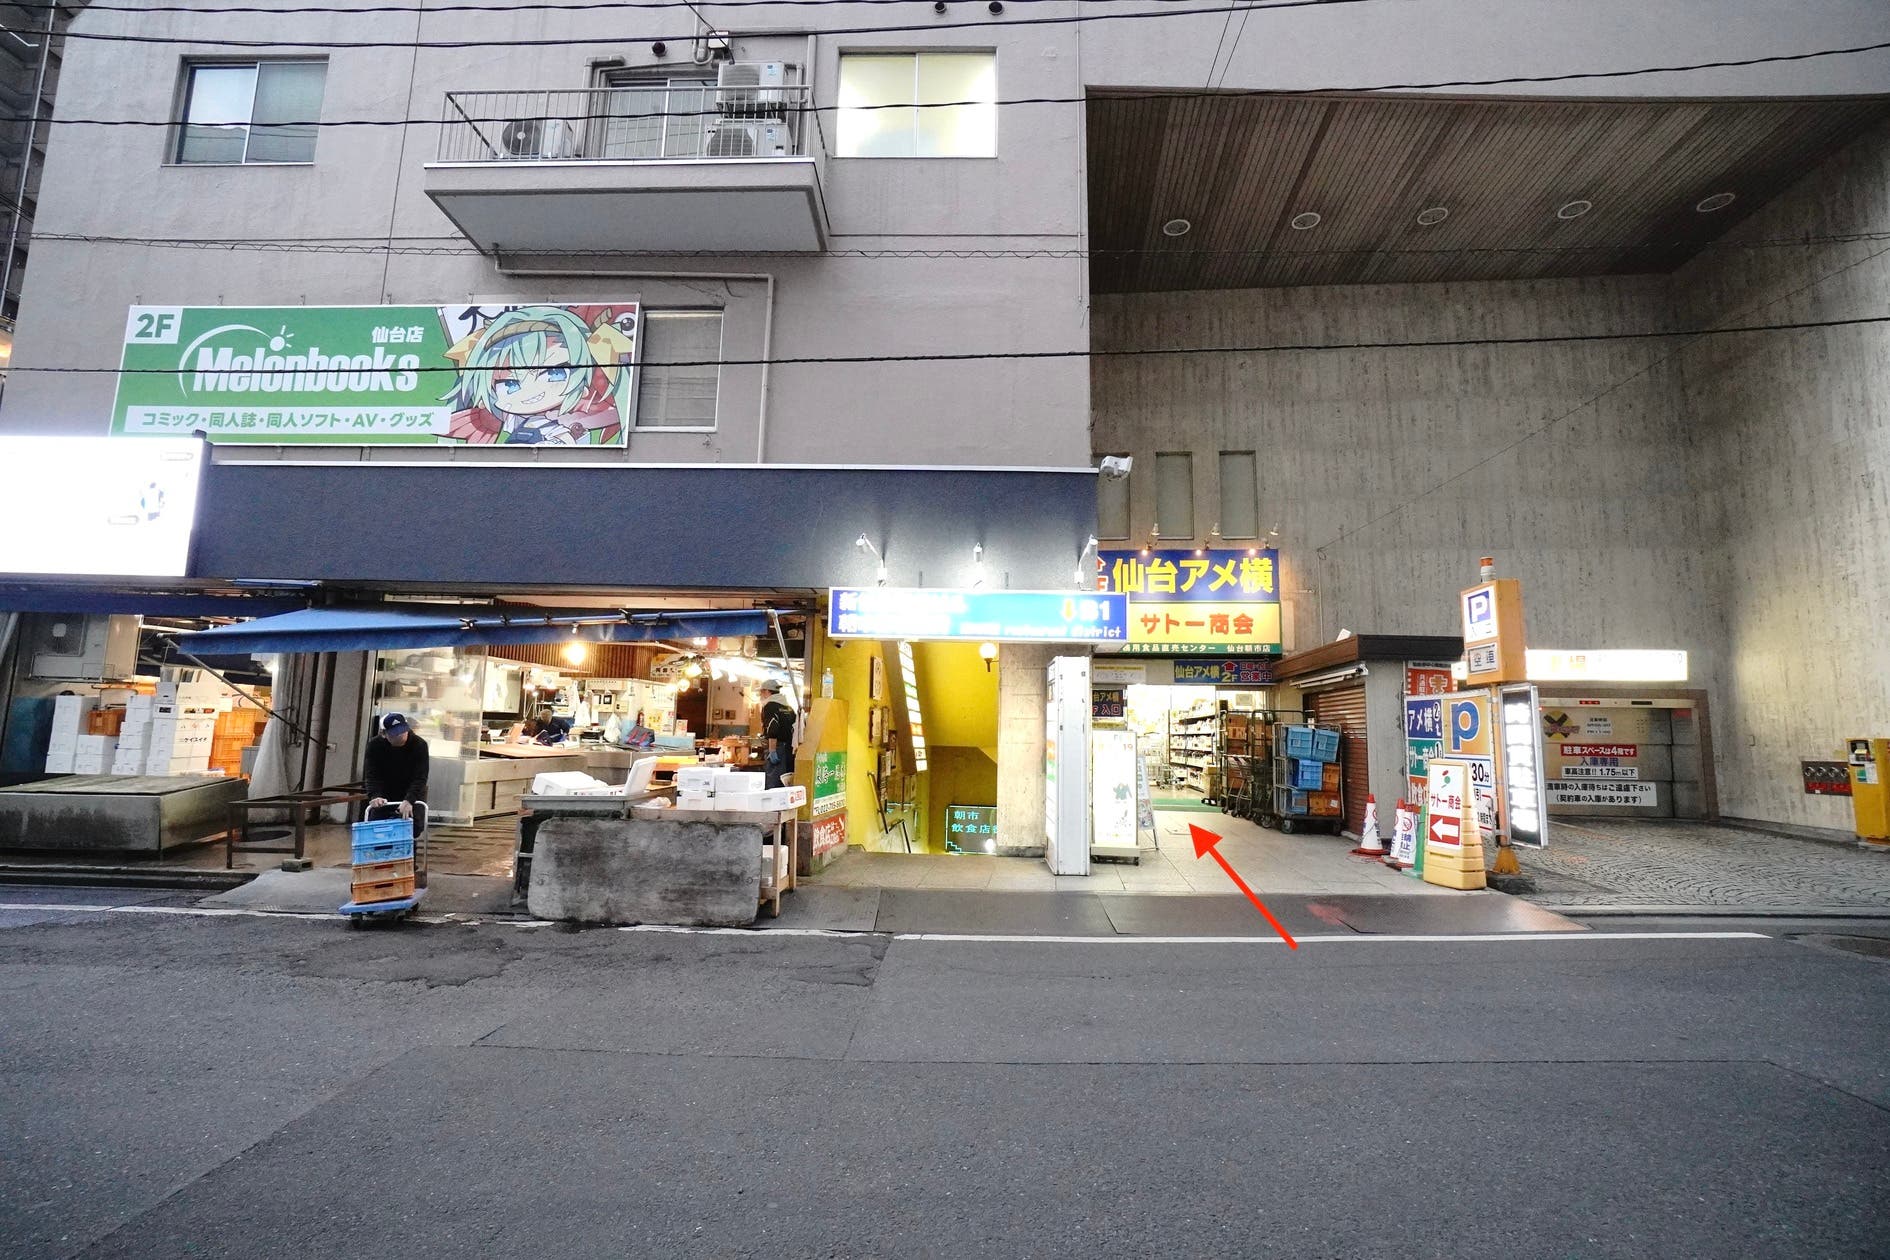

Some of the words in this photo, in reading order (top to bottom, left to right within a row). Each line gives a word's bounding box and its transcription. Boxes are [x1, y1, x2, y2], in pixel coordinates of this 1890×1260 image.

[134, 312, 175, 338] 2F
[371, 326, 424, 344] 仙台店
[193, 346, 420, 393] Melonbooks
[1112, 558, 1274, 594] 仙台アメ横
[1470, 594, 1488, 623] P
[1140, 612, 1254, 635] サトー商会
[1174, 664, 1220, 679] 仙台アメ横
[1221, 672, 1238, 682] 2F
[1240, 671, 1272, 682] 営業中
[1408, 706, 1433, 732] アメ横
[1429, 793, 1462, 811] サトー商会
[953, 810, 980, 820] 朝市
